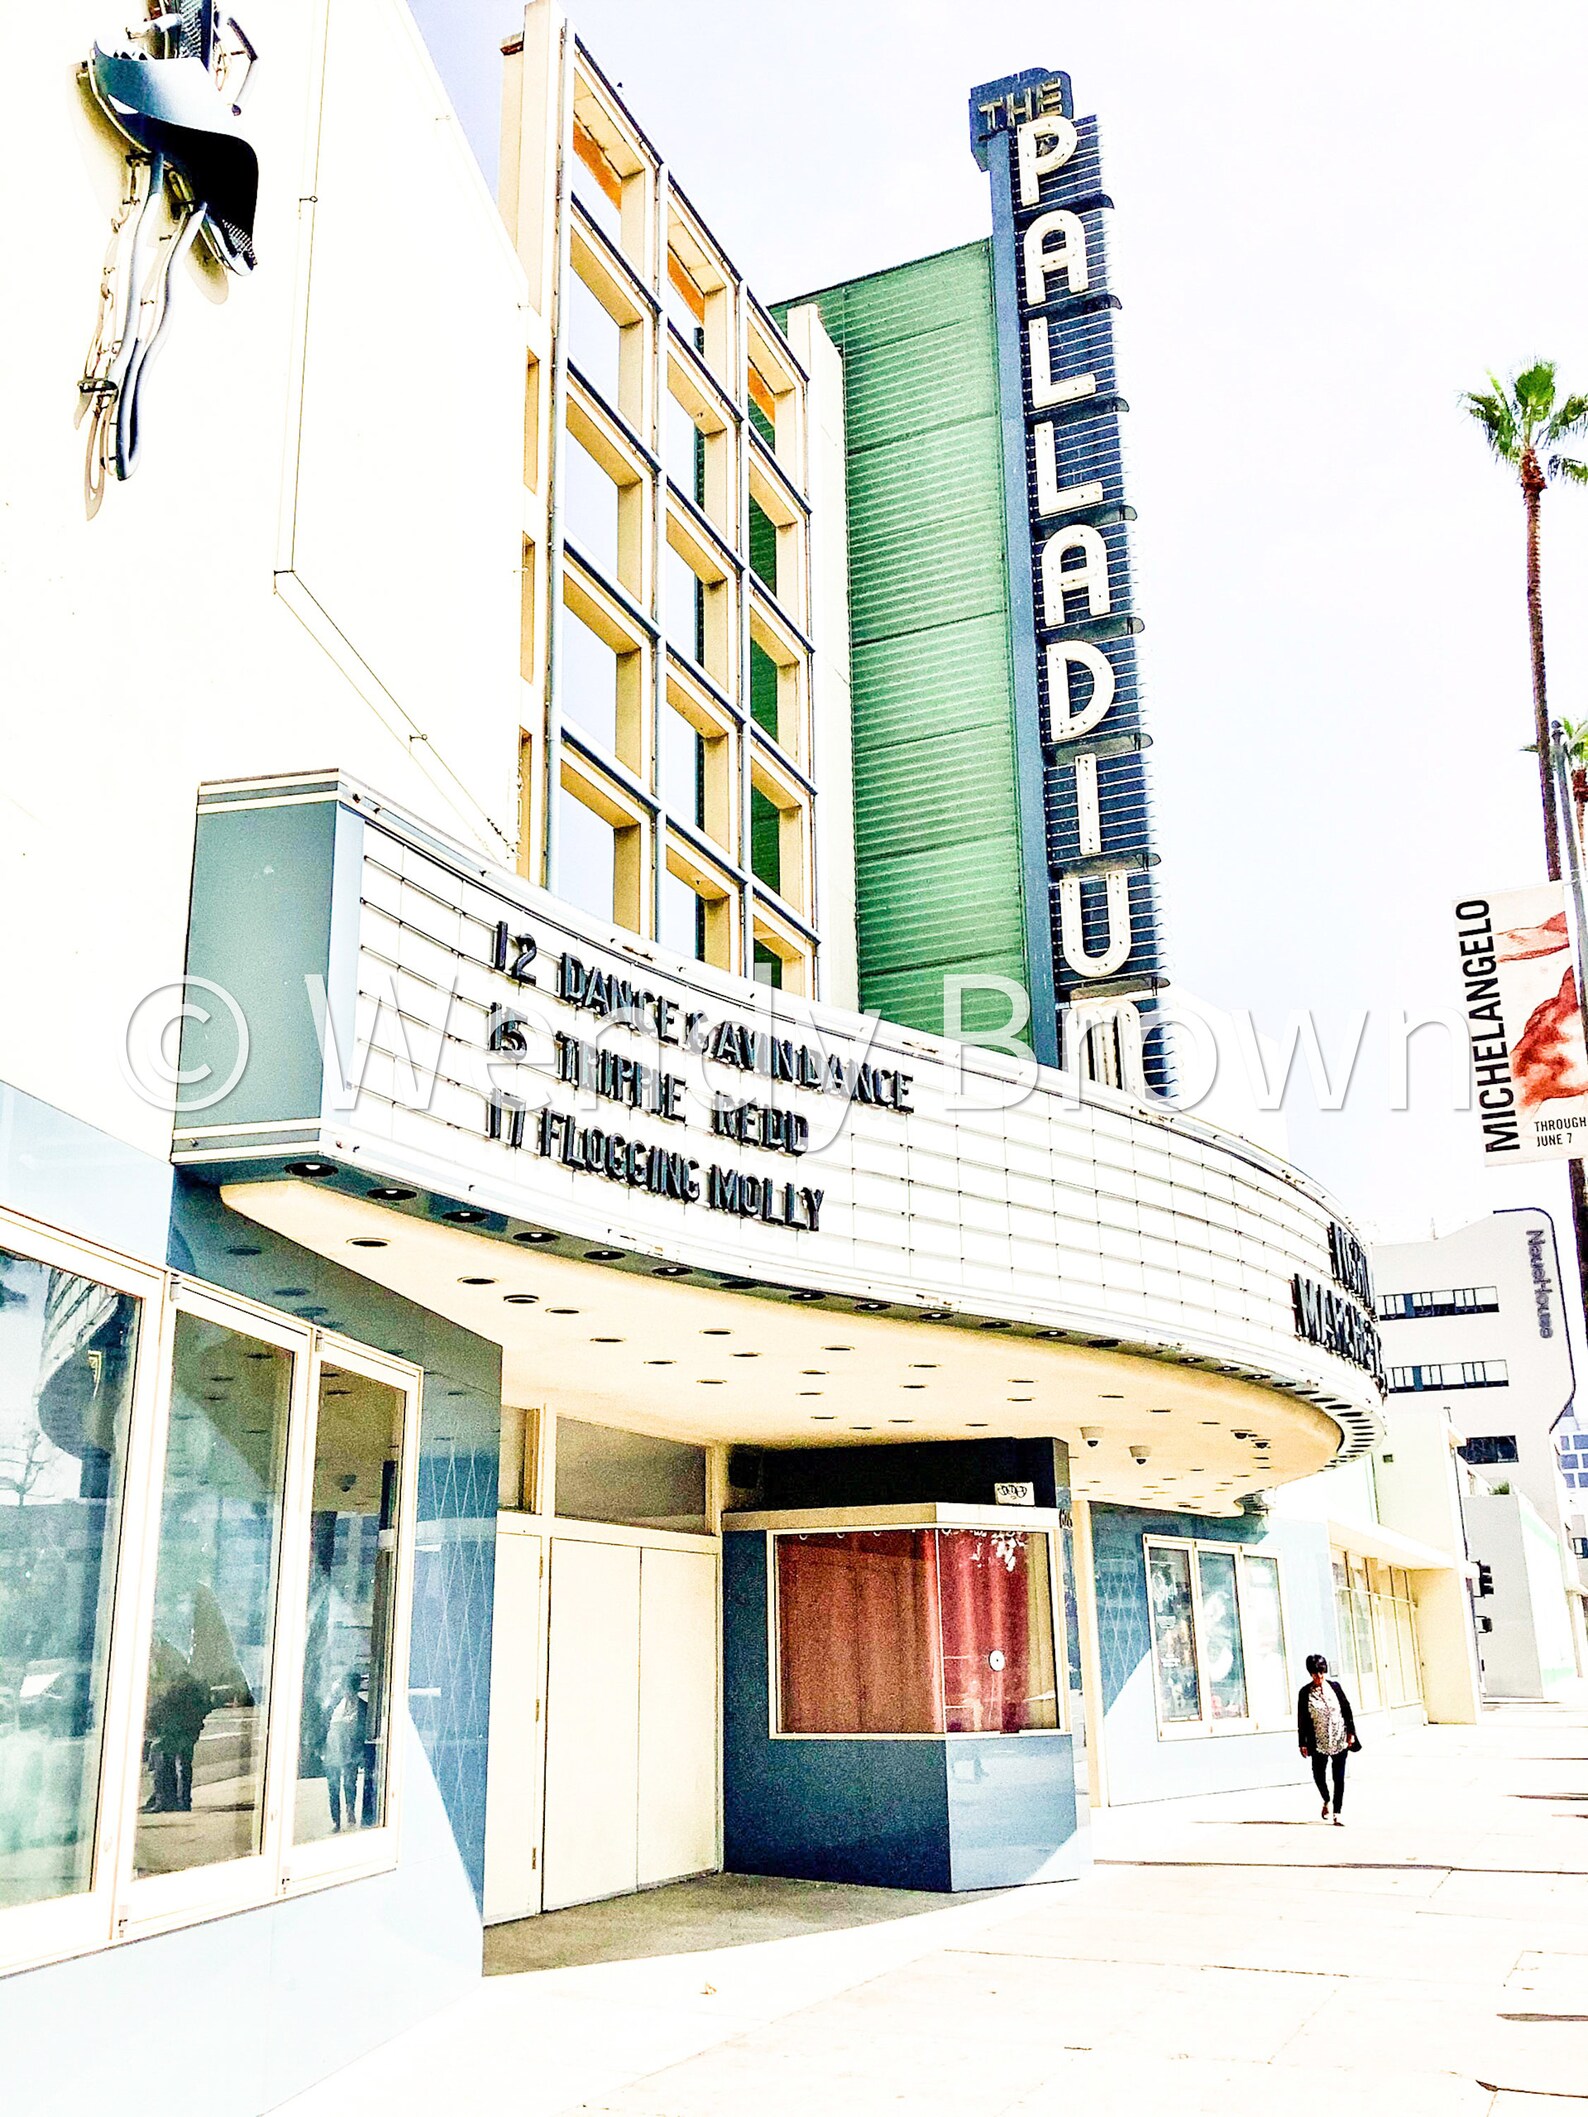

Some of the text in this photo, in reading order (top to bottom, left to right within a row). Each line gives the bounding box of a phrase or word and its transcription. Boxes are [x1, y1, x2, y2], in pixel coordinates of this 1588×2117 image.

[978, 78, 1062, 131] THE
[1017, 115, 1146, 1100] PALLADIUM
[494, 920, 914, 1114] 12 DANCE GAVIN DANCE
[1455, 899, 1521, 1153] MICHELANGELO
[489, 1087, 825, 1232] 17 FLOGGING MOLLY
[711, 1090, 810, 1157] REDD
[1533, 1116, 1587, 1132] THROUGH
[1536, 1132, 1573, 1148] JUNE 7
